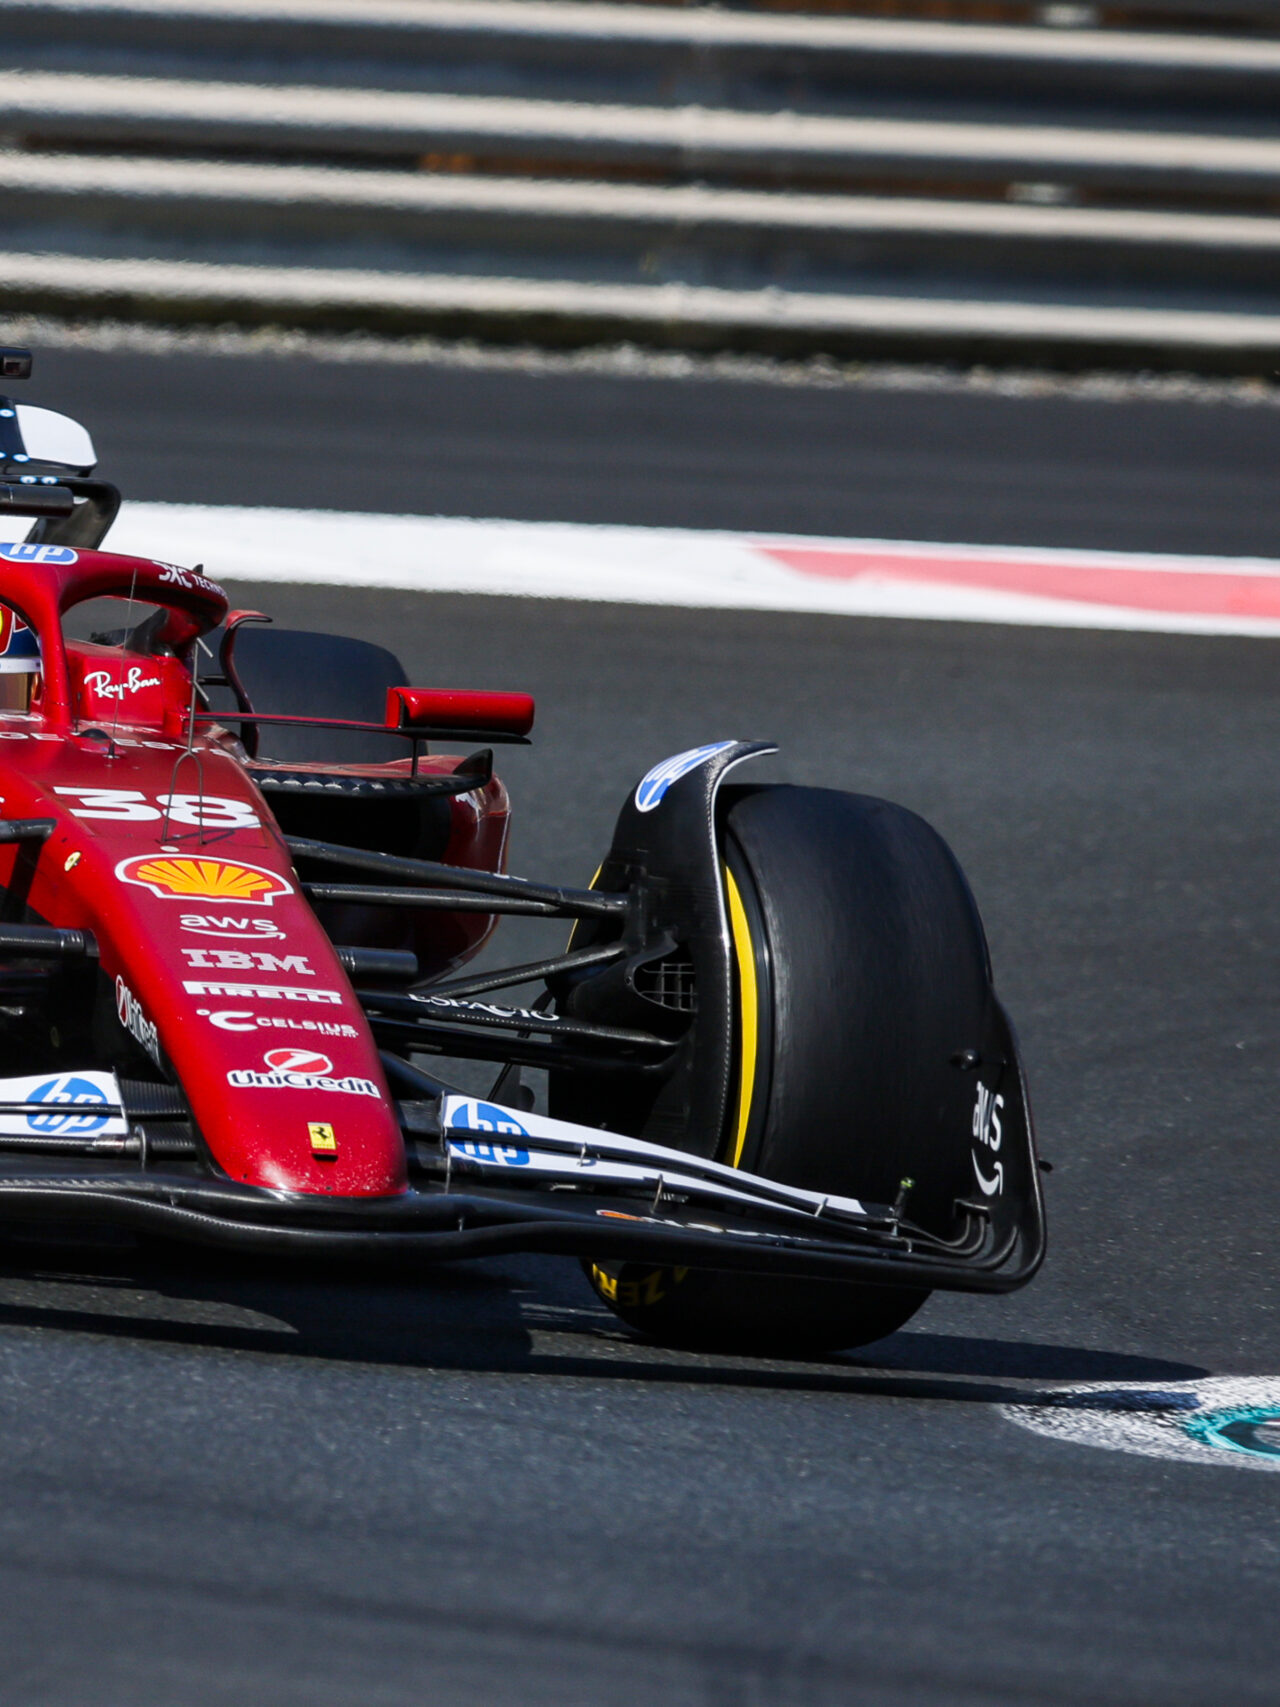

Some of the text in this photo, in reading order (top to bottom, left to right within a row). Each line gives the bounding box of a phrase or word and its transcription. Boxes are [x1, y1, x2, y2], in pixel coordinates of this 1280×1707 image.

[84, 667, 161, 699] Ray-Ban
[53, 785, 262, 829] 38
[179, 914, 280, 934] aws
[180, 949, 316, 976] IBM
[182, 981, 343, 1005] PIRELLI
[256, 1017, 357, 1034] CELSIUS
[228, 1070, 381, 1098] UniCredit
[31, 1077, 105, 1134] hp
[462, 1101, 523, 1166] hp
